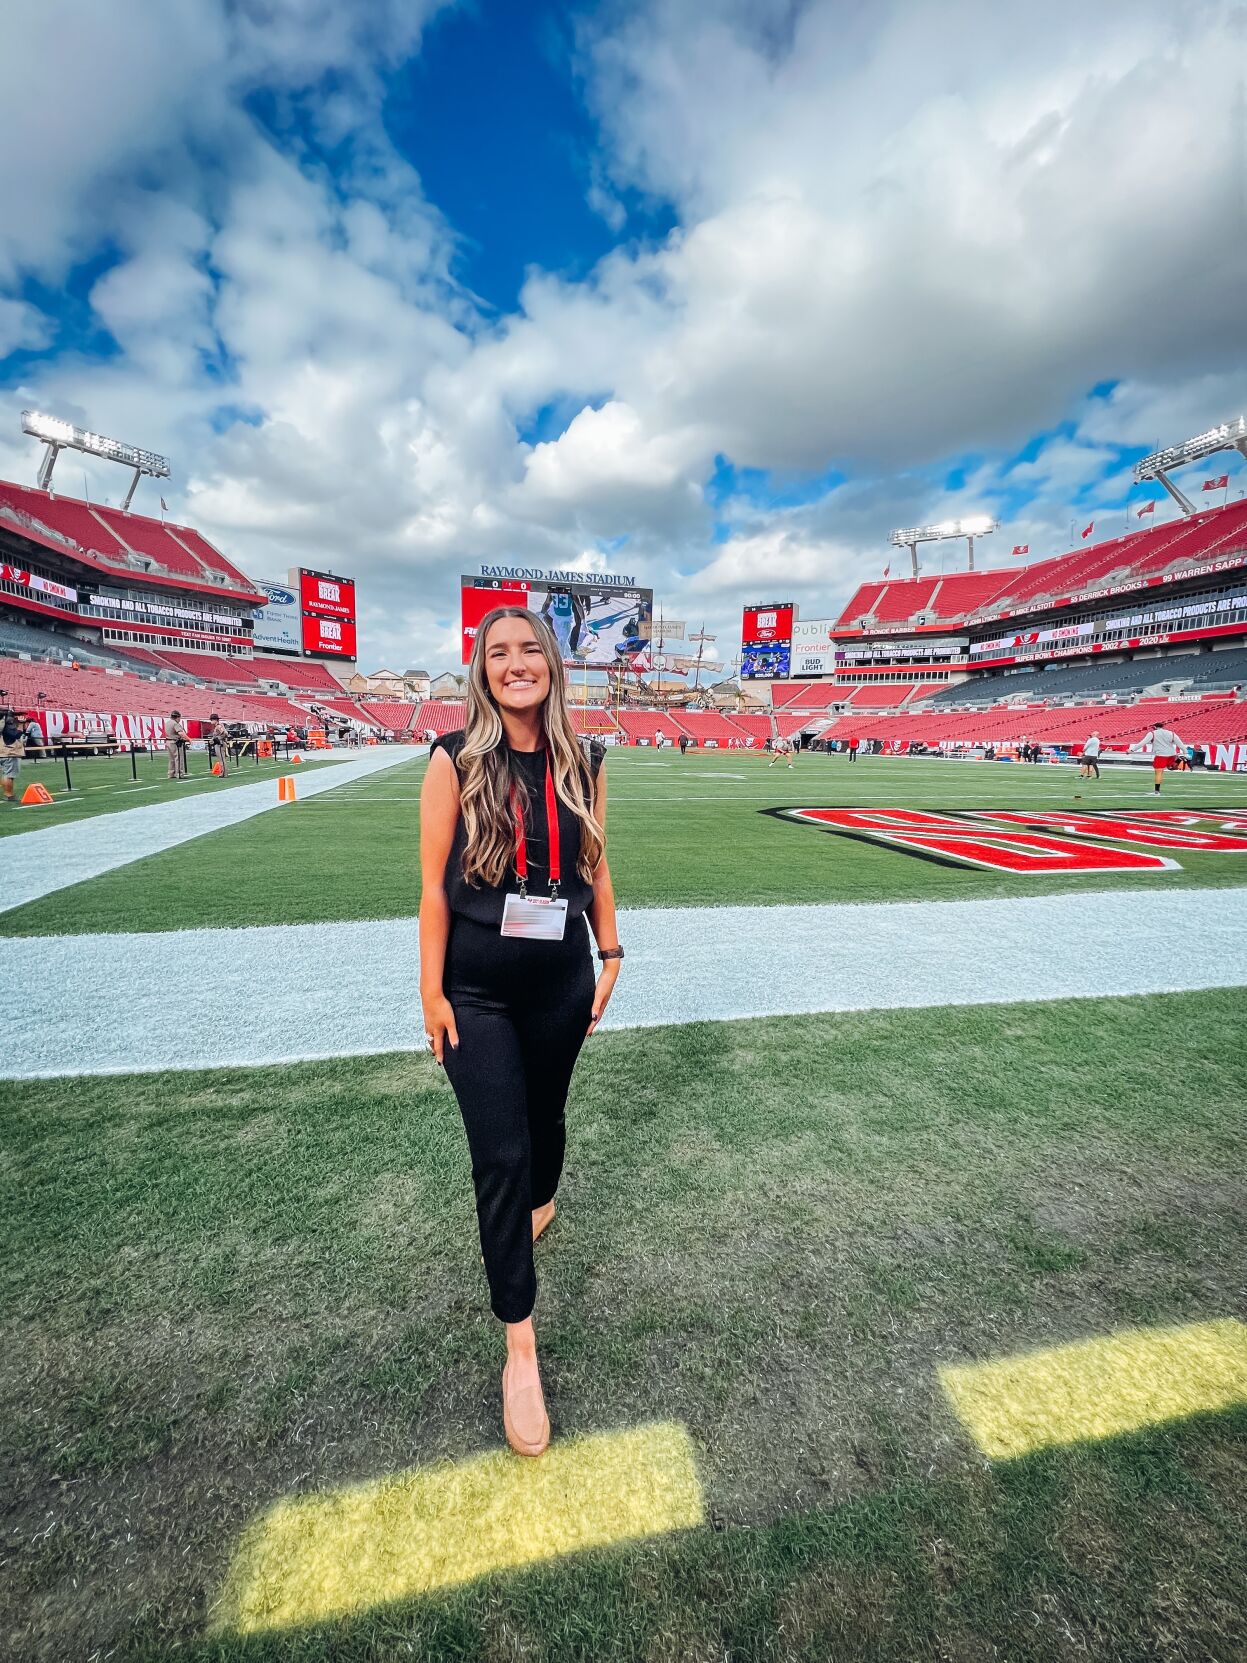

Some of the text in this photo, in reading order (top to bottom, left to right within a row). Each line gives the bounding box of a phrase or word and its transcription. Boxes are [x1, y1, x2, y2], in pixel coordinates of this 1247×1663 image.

[481, 565, 635, 586] RAYMOND JAMES STADIUM
[1174, 565, 1213, 580] WARREN
[1215, 558, 1241, 571] SAPP
[1079, 588, 1108, 601] DERRICK
[1110, 581, 1142, 594] BROOKS
[90, 595, 242, 627] SMOKING AND ALL TOBACCO PRODUCTS ARE PROHIBITED
[1016, 607, 1030, 615] MIKE
[1105, 617, 1130, 630] SMOKING
[1131, 615, 1142, 625] AND
[1143, 613, 1153, 624] ALL
[1155, 608, 1182, 621] TOBACCO
[1183, 601, 1216, 618] PRODUCTS
[1217, 598, 1231, 611] ARE
[891, 626, 915, 634] BARBER
[253, 633, 298, 645] AdventHealth
[319, 642, 342, 651] Frontier
[1139, 637, 1158, 646] 2020
[795, 644, 831, 653] Frontier
[1015, 642, 1118, 663] SUPER BOWL CHAMPIONS 2002
